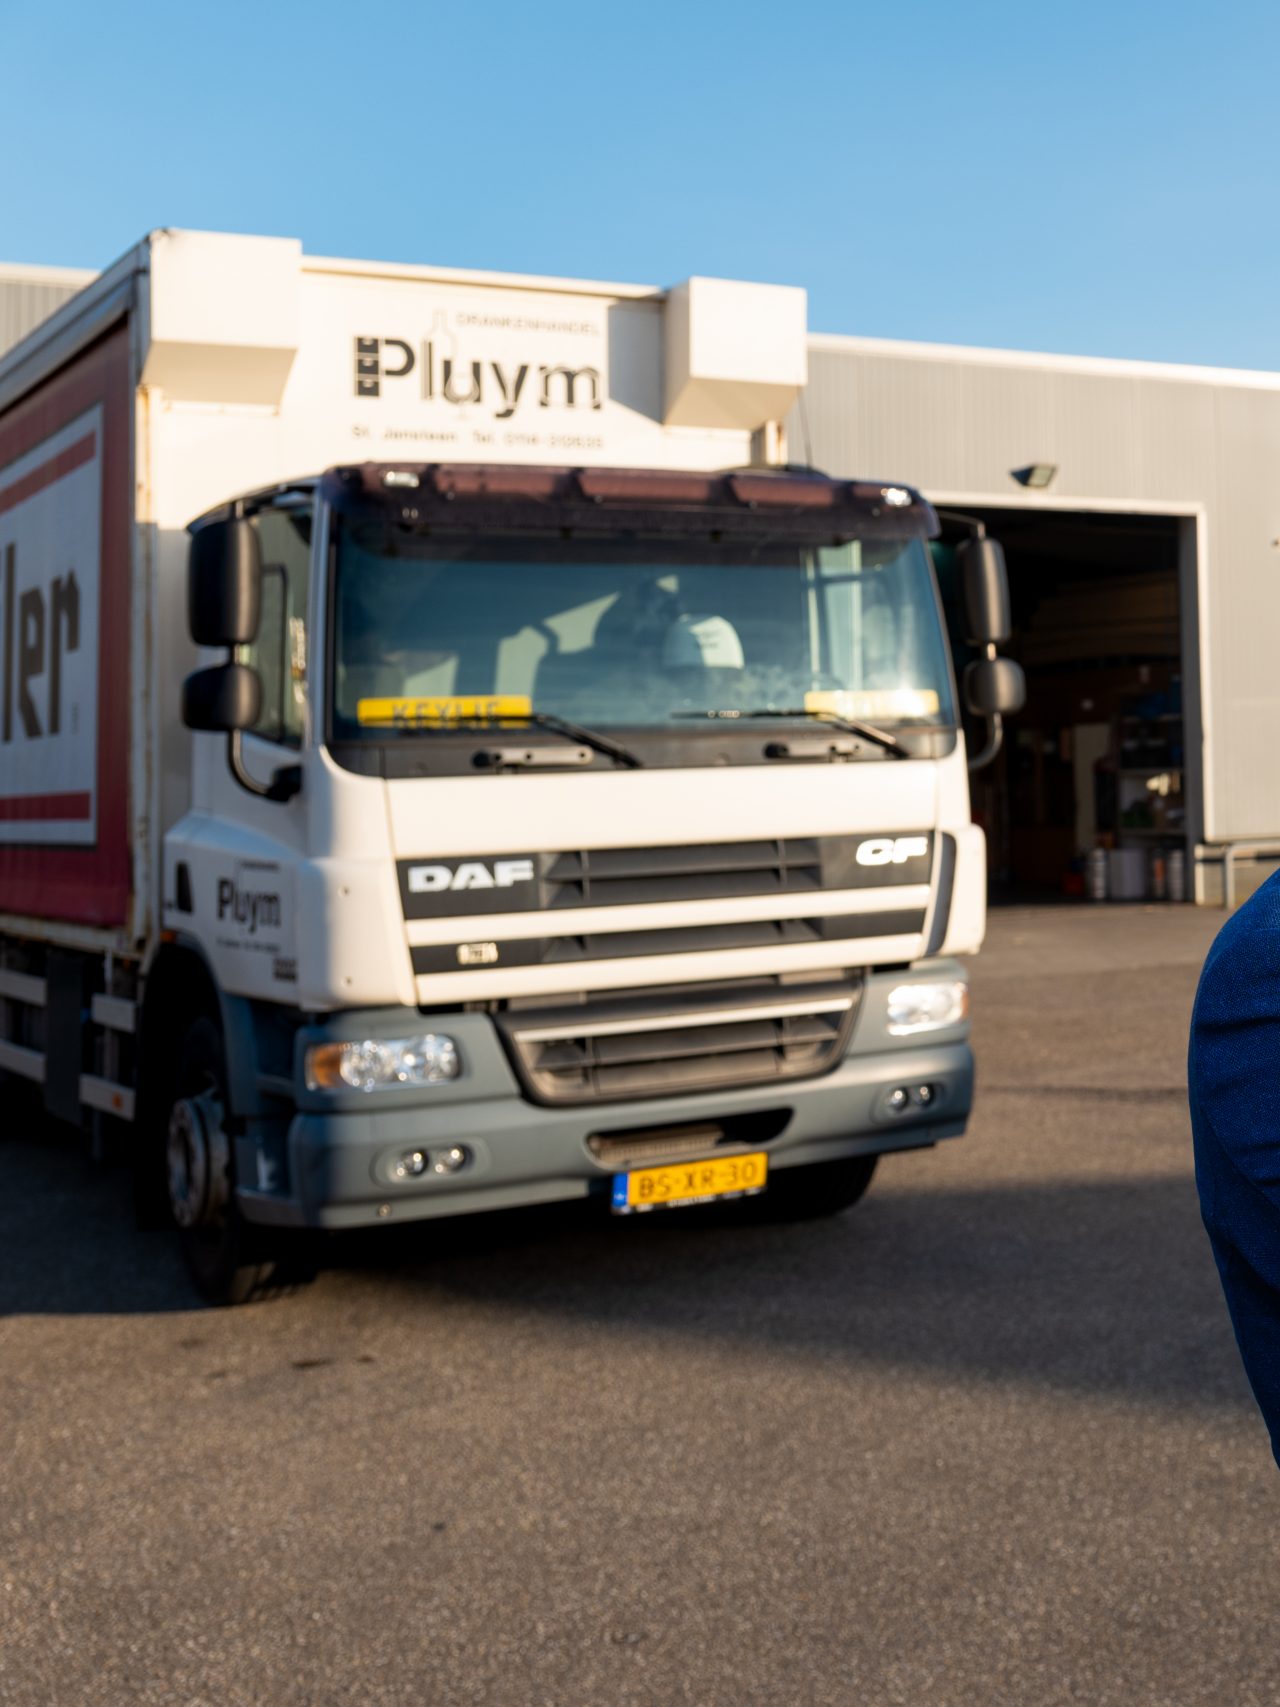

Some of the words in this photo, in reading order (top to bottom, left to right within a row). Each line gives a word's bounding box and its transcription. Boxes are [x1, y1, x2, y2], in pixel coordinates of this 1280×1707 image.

[354, 336, 601, 418] Pluym
[856, 836, 928, 867] CF
[408, 859, 535, 893] DAF
[217, 877, 281, 935] Pluym
